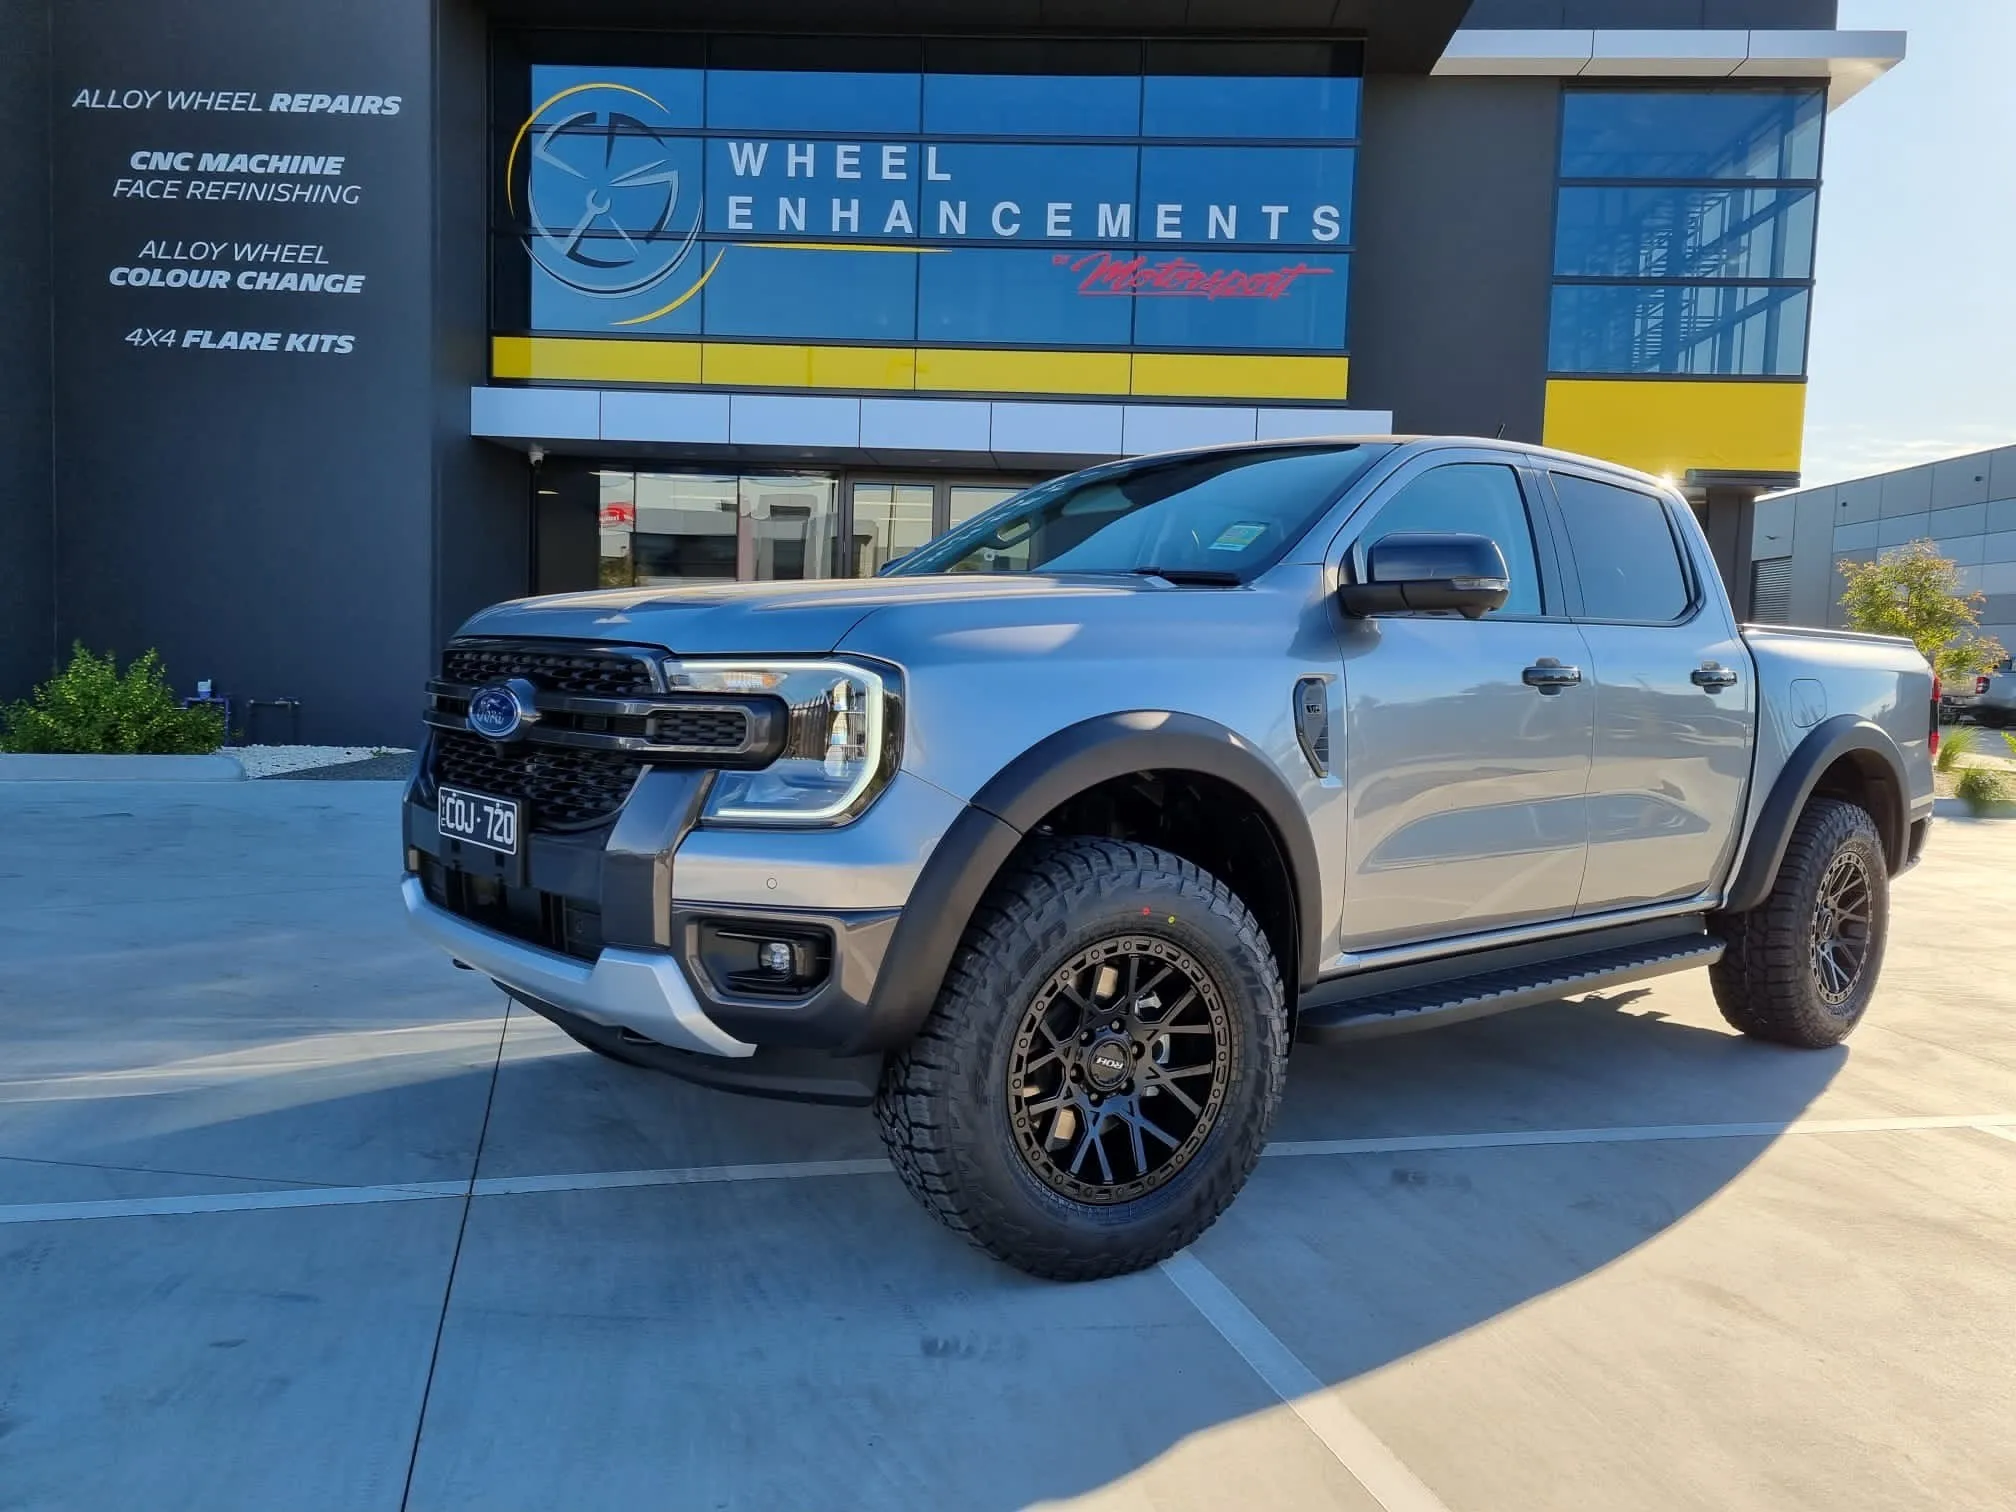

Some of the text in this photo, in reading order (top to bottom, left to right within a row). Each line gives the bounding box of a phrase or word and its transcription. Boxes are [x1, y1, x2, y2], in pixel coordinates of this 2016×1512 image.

[72, 88, 402, 115] ALLOY WHEEL REPAIRS
[130, 151, 345, 175] CNC MACHINE
[728, 142, 952, 181] WHEEL
[112, 178, 361, 204] FACE REFINISHING
[728, 196, 1341, 241] ENHANCEMENTS
[138, 240, 329, 265] ALLOY WHEEL
[109, 267, 365, 293] COLOUR CHANGE
[1070, 250, 1335, 301] Motorsport
[125, 328, 355, 354] 4X4 FLARE KITS
